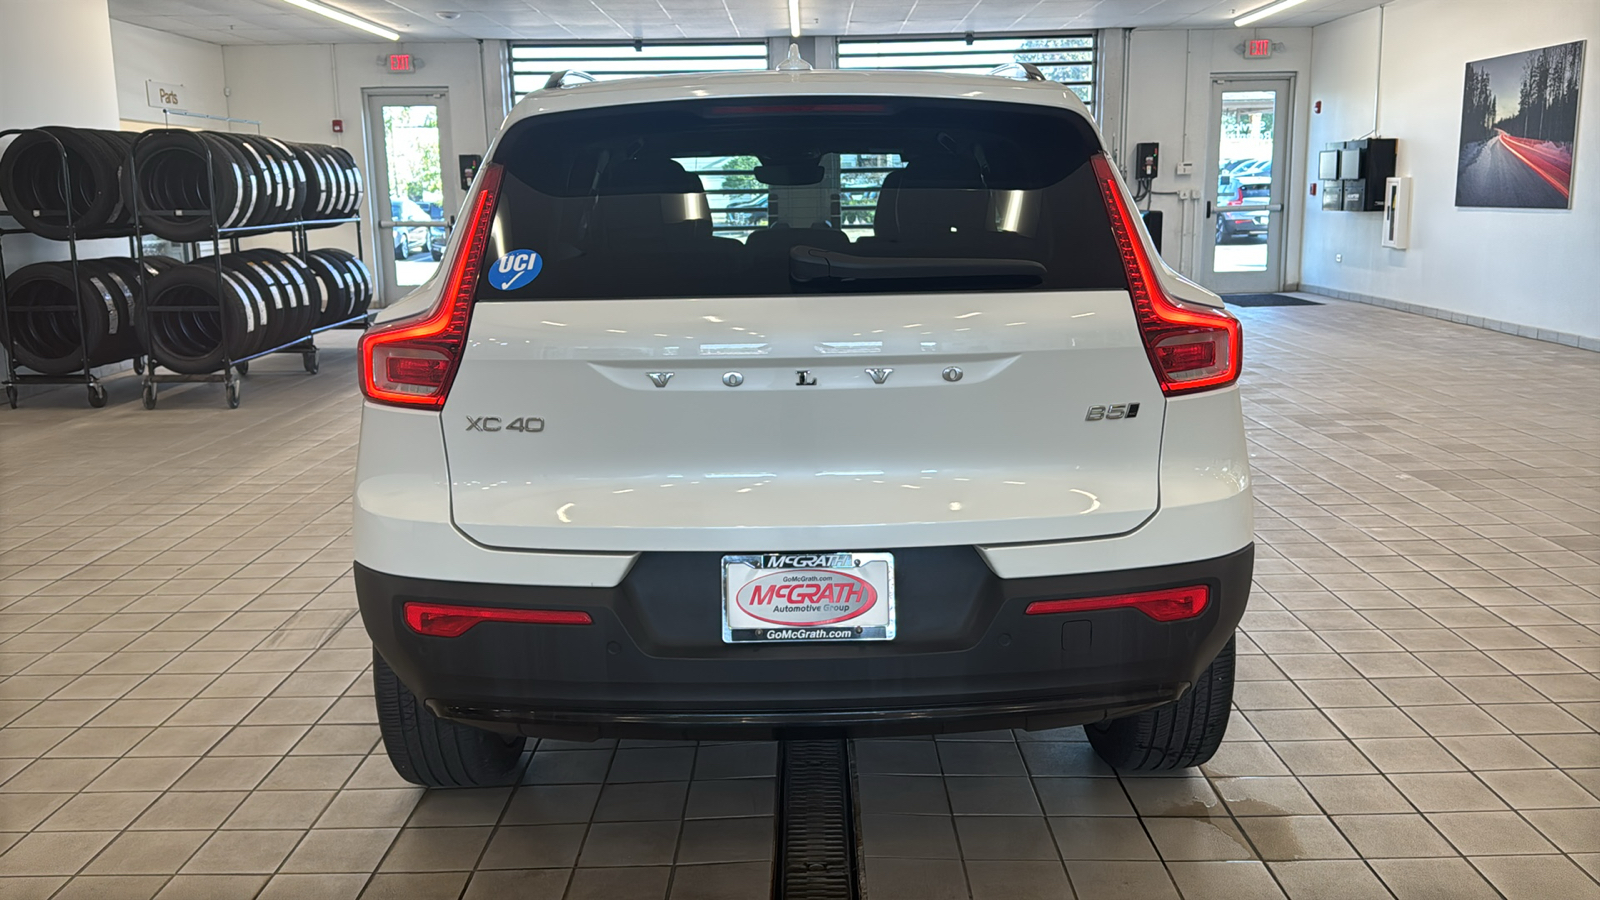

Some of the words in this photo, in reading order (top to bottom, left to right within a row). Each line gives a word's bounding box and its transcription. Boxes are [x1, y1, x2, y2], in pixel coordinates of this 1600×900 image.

[1249, 39, 1269, 56] EXIT
[390, 54, 409, 70] EXIT
[499, 253, 537, 273] UCI
[646, 366, 964, 388] VOLVO
[1085, 404, 1126, 421] B5
[767, 555, 849, 568] McGRATH
[782, 575, 833, 583] GoMcGrath.com
[749, 582, 865, 606] McGRATH
[773, 604, 821, 613] Automotive
[823, 604, 850, 613] Group
[766, 629, 852, 640] GoMcGrath.com
